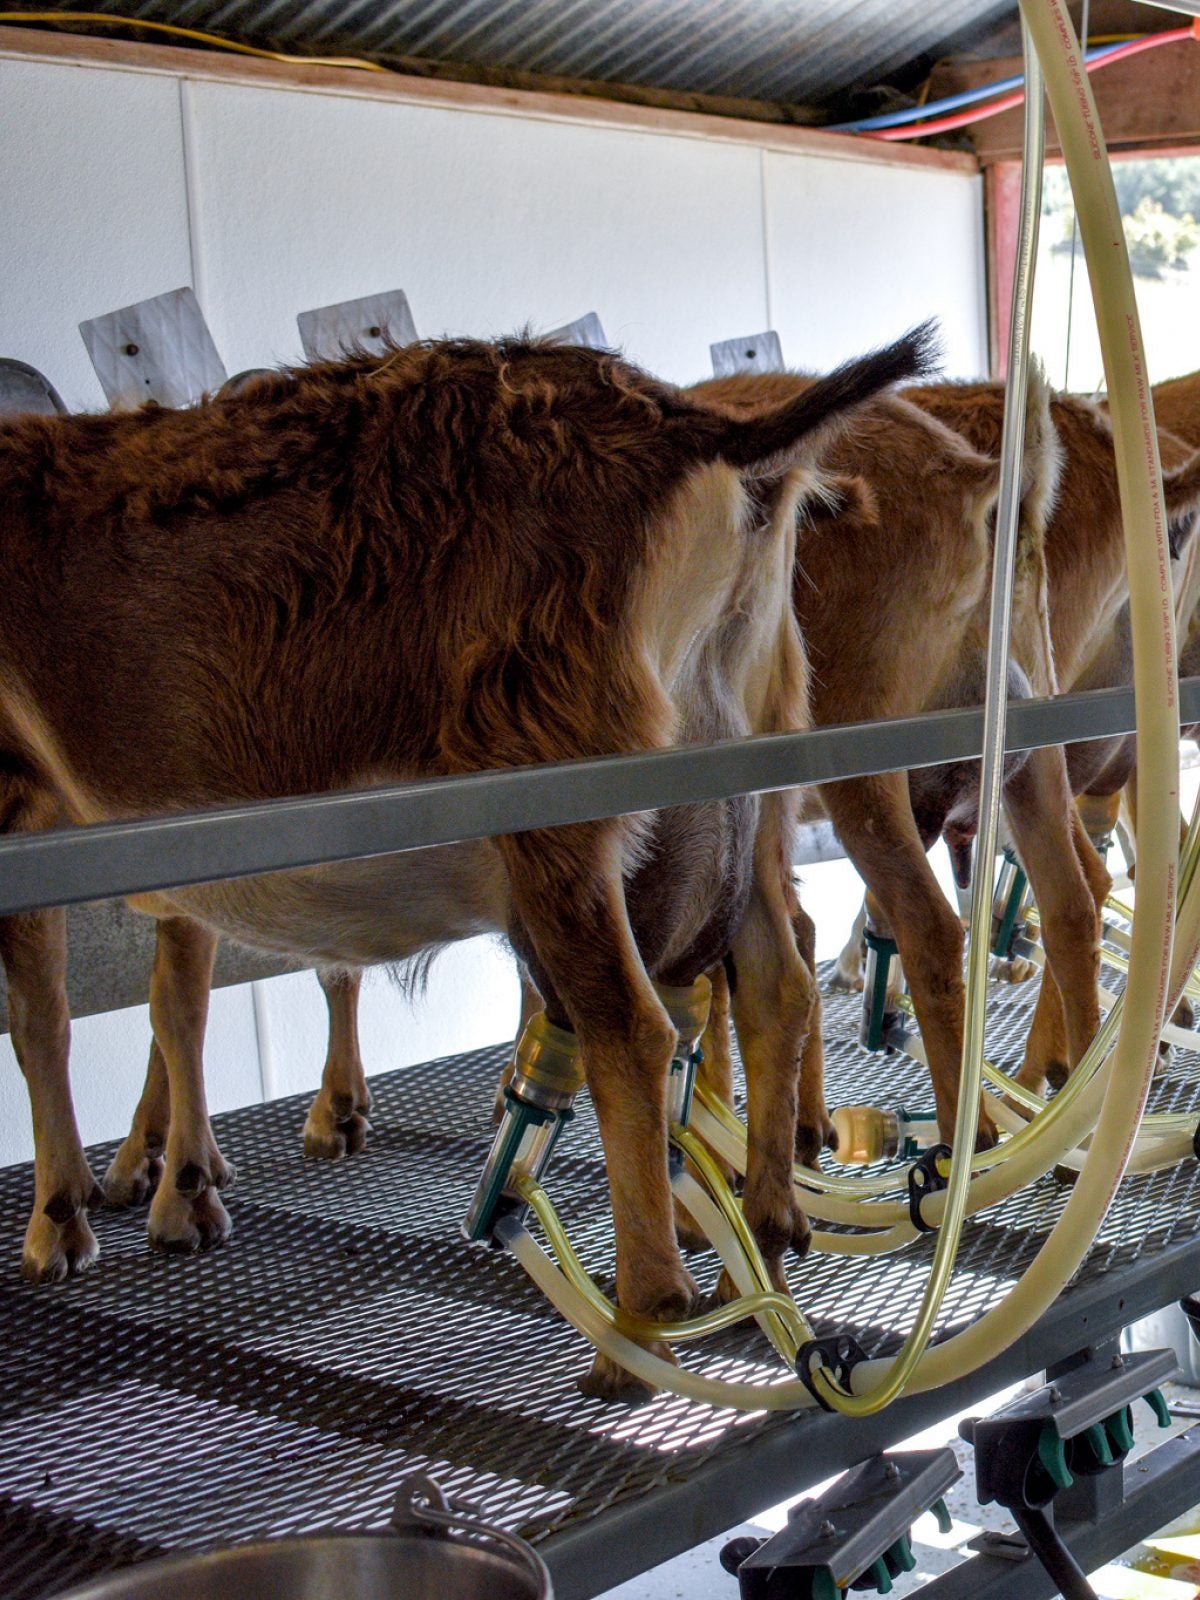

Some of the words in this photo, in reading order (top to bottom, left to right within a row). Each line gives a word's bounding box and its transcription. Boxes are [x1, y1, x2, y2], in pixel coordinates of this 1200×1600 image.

[1125, 313, 1138, 351] SERVICE
[1132, 353, 1142, 375] MILK
[1136, 377, 1145, 399] RAW
[1139, 401, 1148, 420] FOR
[1142, 422, 1156, 476] STANDARDS
[1152, 502, 1160, 519] FDA
[1154, 521, 1163, 545] WITH
[1157, 547, 1167, 592] COMPLIES
[1163, 631, 1172, 663] TUBING
[1165, 666, 1174, 707] SILICONE
[1166, 863, 1174, 899] SERVICE
[1163, 925, 1171, 945] RAW
